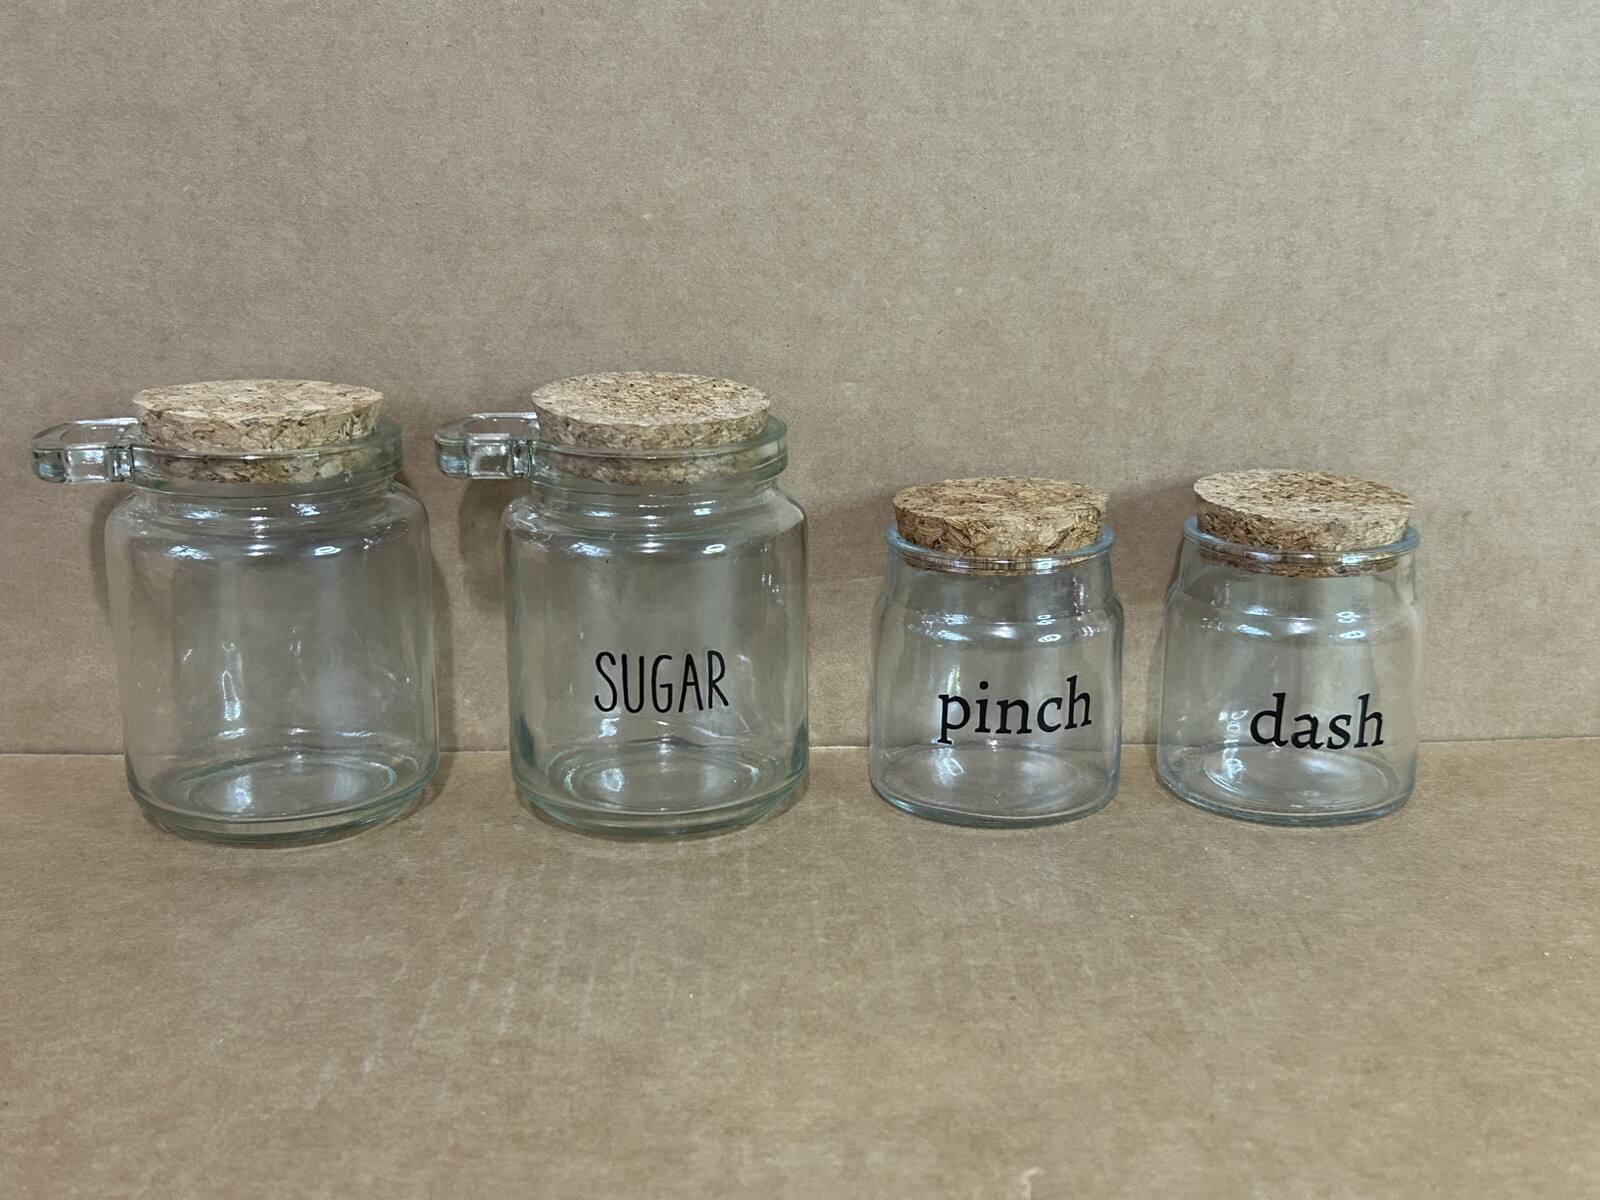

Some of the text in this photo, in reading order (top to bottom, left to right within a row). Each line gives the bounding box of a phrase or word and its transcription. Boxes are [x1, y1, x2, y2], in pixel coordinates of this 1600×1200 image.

[594, 650, 730, 714] SUGAR
[937, 674, 1092, 746] pinch
[1250, 692, 1384, 750] dash
